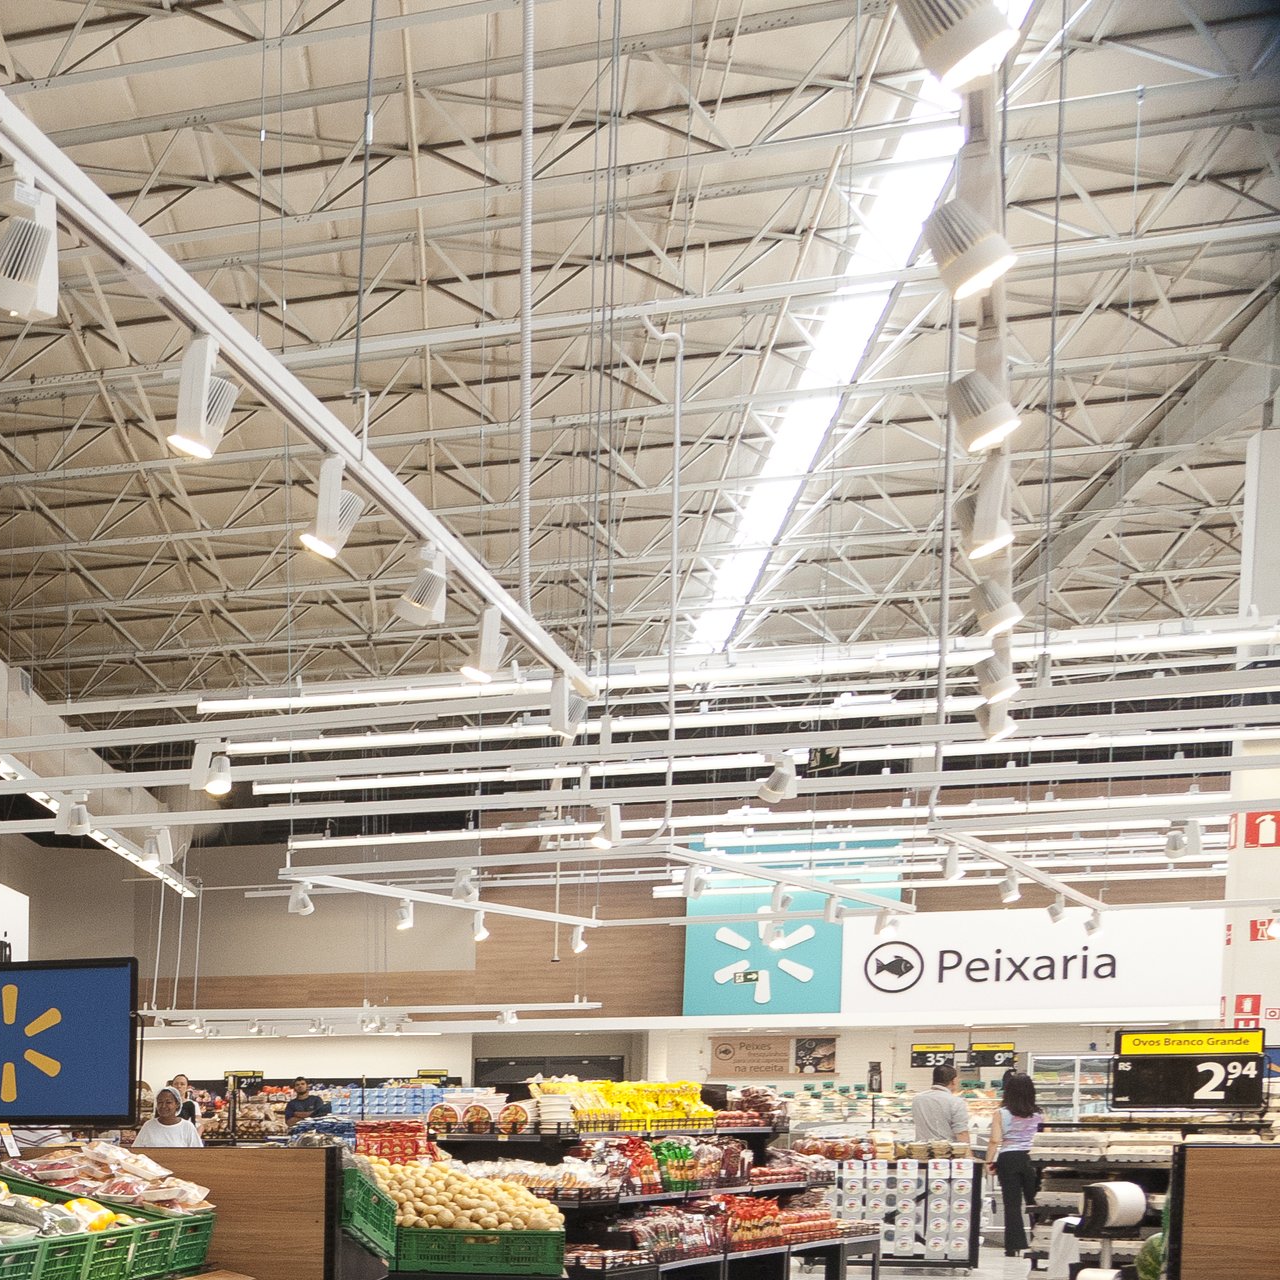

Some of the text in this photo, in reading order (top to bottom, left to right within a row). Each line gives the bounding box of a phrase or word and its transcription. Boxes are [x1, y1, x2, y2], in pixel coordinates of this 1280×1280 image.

[937, 945, 1118, 984] Peixaria
[1132, 1037, 1250, 1047] Ovos Branco Grande
[1193, 1061, 1258, 1100] 2,94
